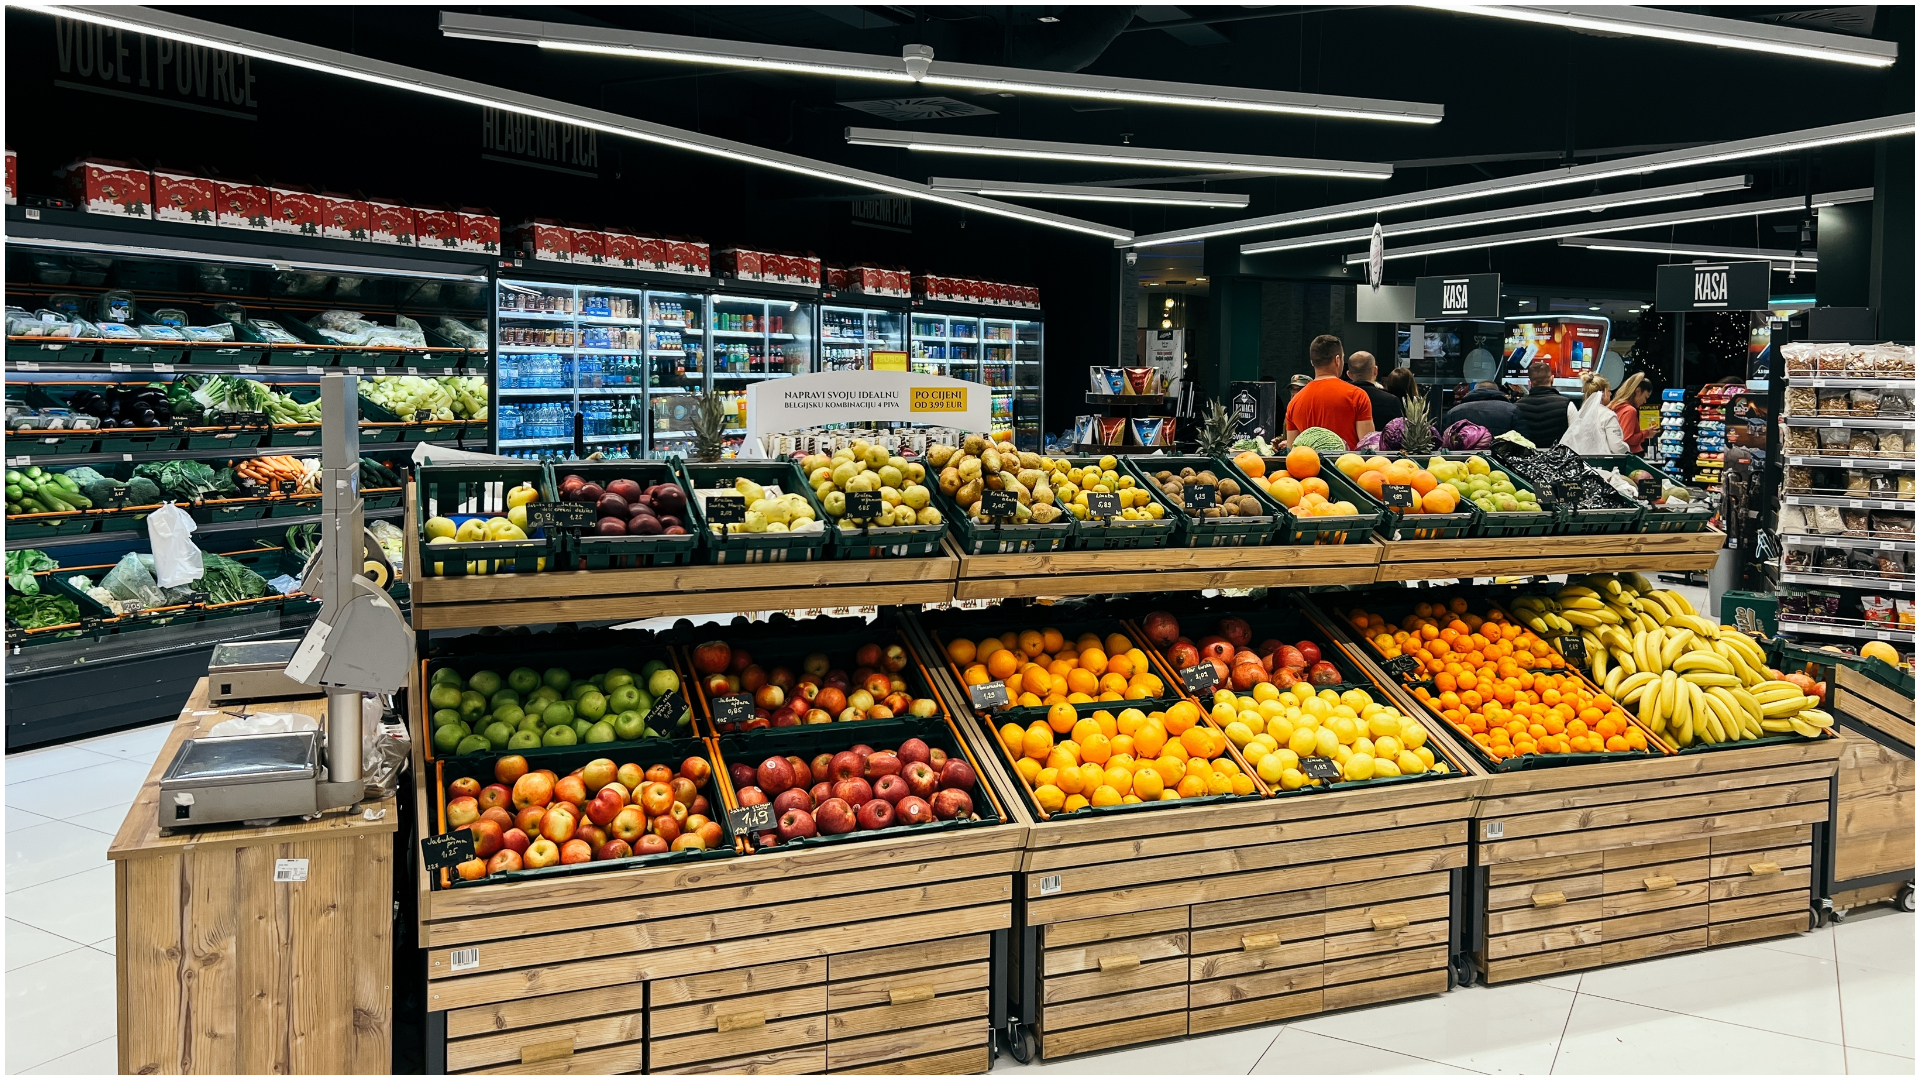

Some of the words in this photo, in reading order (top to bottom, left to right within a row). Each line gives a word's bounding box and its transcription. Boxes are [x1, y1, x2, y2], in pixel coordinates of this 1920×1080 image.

[138, 33, 150, 87] I
[1694, 272, 1728, 300] KASA
[1443, 285, 1468, 309] KASA
[784, 391, 825, 400] NAPRAVI
[827, 391, 856, 401] SVOJU
[858, 391, 899, 399] IDEALNU
[915, 391, 929, 399] PO
[931, 391, 962, 399] CIJENI
[741, 811, 769, 827] 1,49
[427, 835, 456, 845] Jabuka
[441, 847, 458, 858] 1,25
